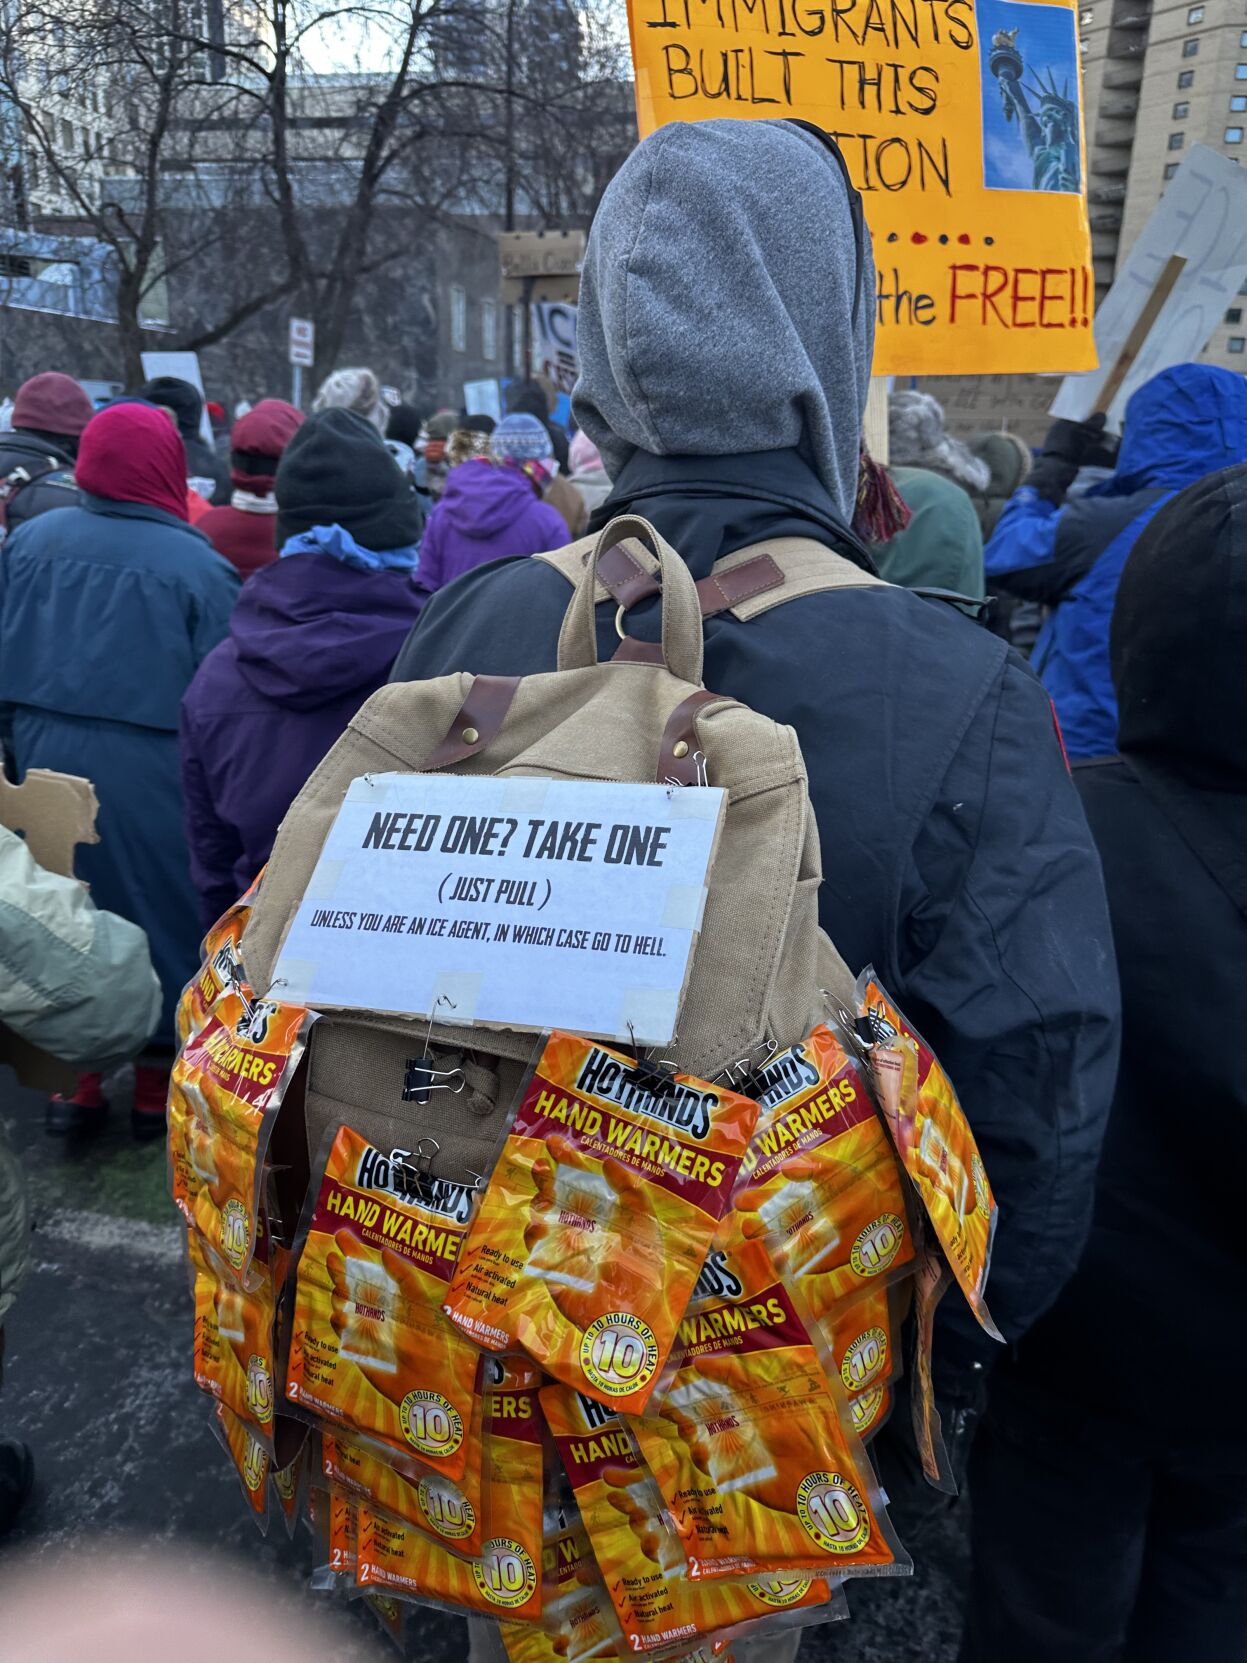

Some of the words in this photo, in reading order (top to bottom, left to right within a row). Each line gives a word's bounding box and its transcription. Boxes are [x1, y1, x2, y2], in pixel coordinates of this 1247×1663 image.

[662, 44, 805, 106] BUILT
[826, 58, 940, 116] THIS
[829, 131, 953, 197] ION
[876, 269, 936, 326] the
[949, 265, 1090, 329] FREE!!
[535, 303, 575, 348] IC
[362, 812, 442, 852] NEED
[440, 815, 518, 857] ONE?
[523, 819, 602, 862] TAKE
[604, 824, 671, 867] ONE
[310, 909, 357, 930] UNLESS
[357, 912, 384, 932] YOU
[382, 915, 408, 934] ARE
[407, 917, 427, 935] AN
[426, 918, 449, 937] ICE
[448, 920, 491, 943] AGENT,
[493, 923, 510, 943] IN
[512, 924, 556, 947] WHICH
[556, 928, 591, 950] CASE
[591, 931, 612, 952] GO
[614, 933, 632, 953] TO
[632, 935, 666, 957] HELL.
[754, 1078, 857, 1158] WARMERS
[534, 1090, 603, 1137] HAND
[606, 1117, 726, 1188] WARMERS
[752, 1146, 794, 1180] CALENTADORES
[793, 1140, 802, 1151] DE
[801, 1127, 823, 1146] MANOS
[580, 1135, 632, 1166] CALENTADORES
[631, 1155, 640, 1167] DE
[641, 1160, 666, 1178] MANOS
[326, 1190, 380, 1228] HAND
[382, 1209, 462, 1262] WARME
[361, 1228, 402, 1250] CALENTADORES
[403, 1245, 411, 1256] DE
[411, 1248, 434, 1265] MANOS
[481, 1245, 502, 1260] Ready
[502, 1254, 510, 1264] to
[510, 1258, 524, 1270] use
[861, 1224, 897, 1267] 10
[473, 1263, 484, 1273] Air
[484, 1268, 516, 1289] activated
[466, 1281, 492, 1300] Natural
[492, 1293, 508, 1306] heat
[452, 1312, 474, 1328] HAND
[474, 1320, 510, 1344] WARMERS
[586, 1331, 594, 1341] TO
[592, 1321, 605, 1332] 10
[605, 1313, 642, 1330] HOURS
[641, 1327, 654, 1342] OF
[678, 1297, 787, 1346] WARMERS
[320, 1340, 327, 1350] to
[327, 1344, 338, 1354] use
[583, 1343, 590, 1353] UP
[598, 1329, 645, 1378] 10
[645, 1345, 657, 1374] HEAT
[713, 1340, 723, 1350] DE
[851, 1339, 880, 1380] 10
[249, 1371, 269, 1409] 10
[288, 1381, 298, 1398] 2
[321, 1375, 334, 1386] heat
[411, 1390, 442, 1403] HOURS
[442, 1401, 453, 1412] OF
[451, 1414, 463, 1438] HEAT
[412, 1404, 451, 1443] 10
[569, 1432, 633, 1464] HAND
[325, 1459, 333, 1475] 2
[832, 1474, 845, 1485] OF
[704, 1487, 716, 1497] use
[800, 1473, 829, 1493] HOURS
[428, 1488, 464, 1527] 10
[797, 1493, 807, 1506] 10
[808, 1489, 860, 1537] 10
[847, 1486, 867, 1515] HEAT
[799, 1510, 807, 1519] TO
[804, 1520, 814, 1531] UP
[332, 1548, 341, 1566] 2
[489, 1538, 513, 1550] OURS
[514, 1545, 527, 1556] OF
[524, 1558, 536, 1583] HEAT
[688, 1556, 701, 1577] 2
[360, 1563, 370, 1582] 2
[386, 1571, 417, 1587] WARMERS
[489, 1554, 526, 1592] 10
[622, 1576, 643, 1587] Ready
[642, 1575, 650, 1584] to
[650, 1572, 663, 1581] use
[639, 1586, 669, 1602] activated
[658, 1602, 674, 1613] heat
[630, 1633, 643, 1651] 2
[641, 1633, 661, 1644] HAND
[661, 1623, 697, 1640] WARMERS
